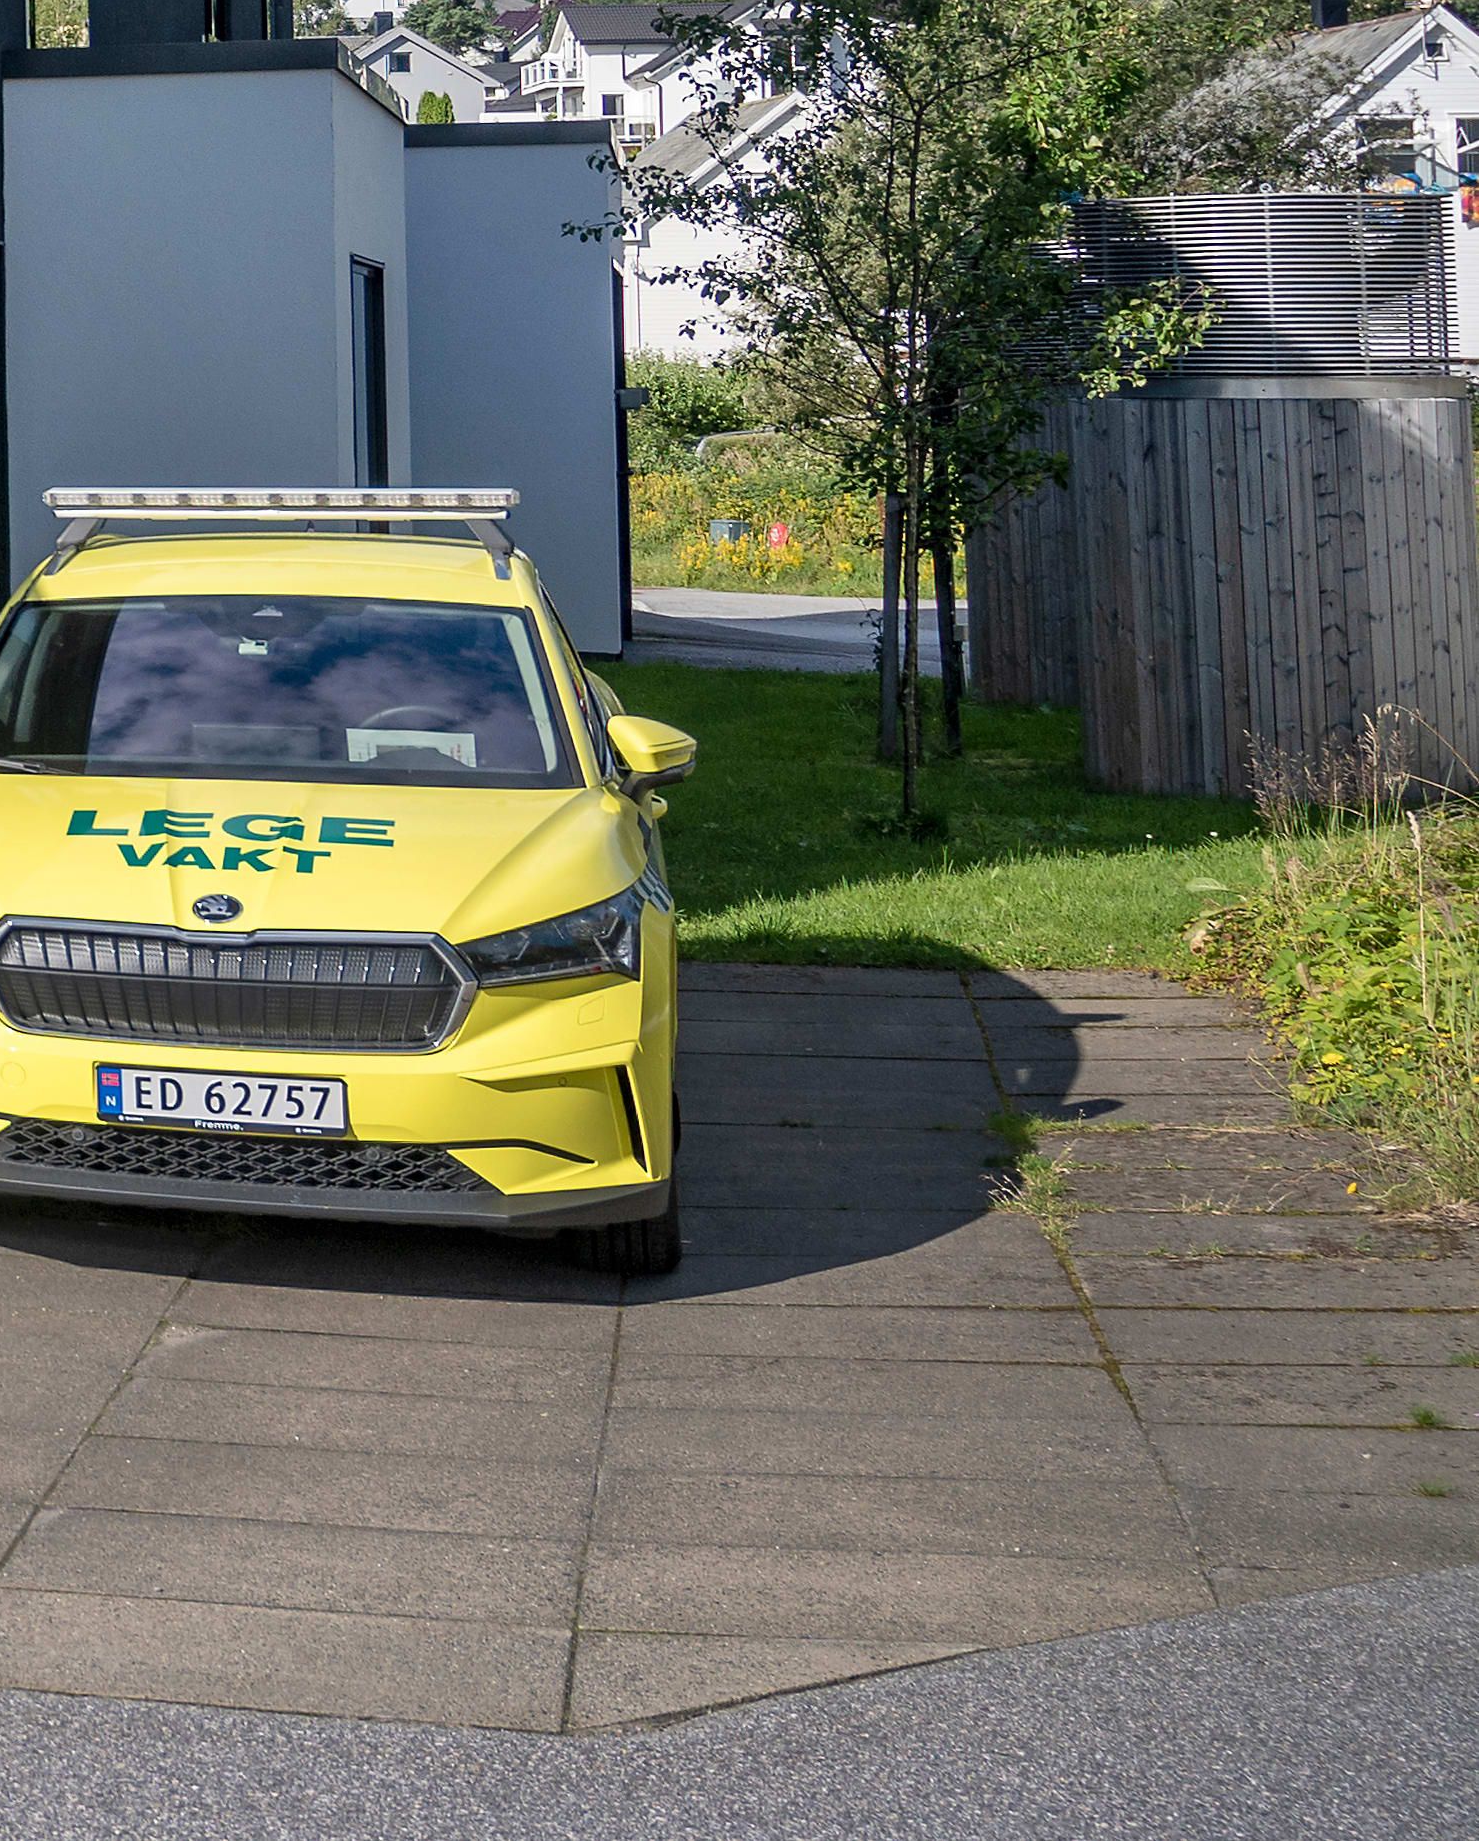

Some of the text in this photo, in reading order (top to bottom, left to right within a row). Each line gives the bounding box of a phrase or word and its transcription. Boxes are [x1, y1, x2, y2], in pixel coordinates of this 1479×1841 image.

[66, 809, 395, 847] LEGE
[117, 842, 331, 874] VAKT
[106, 1096, 116, 1106] N
[134, 1076, 331, 1120] ED 62757
